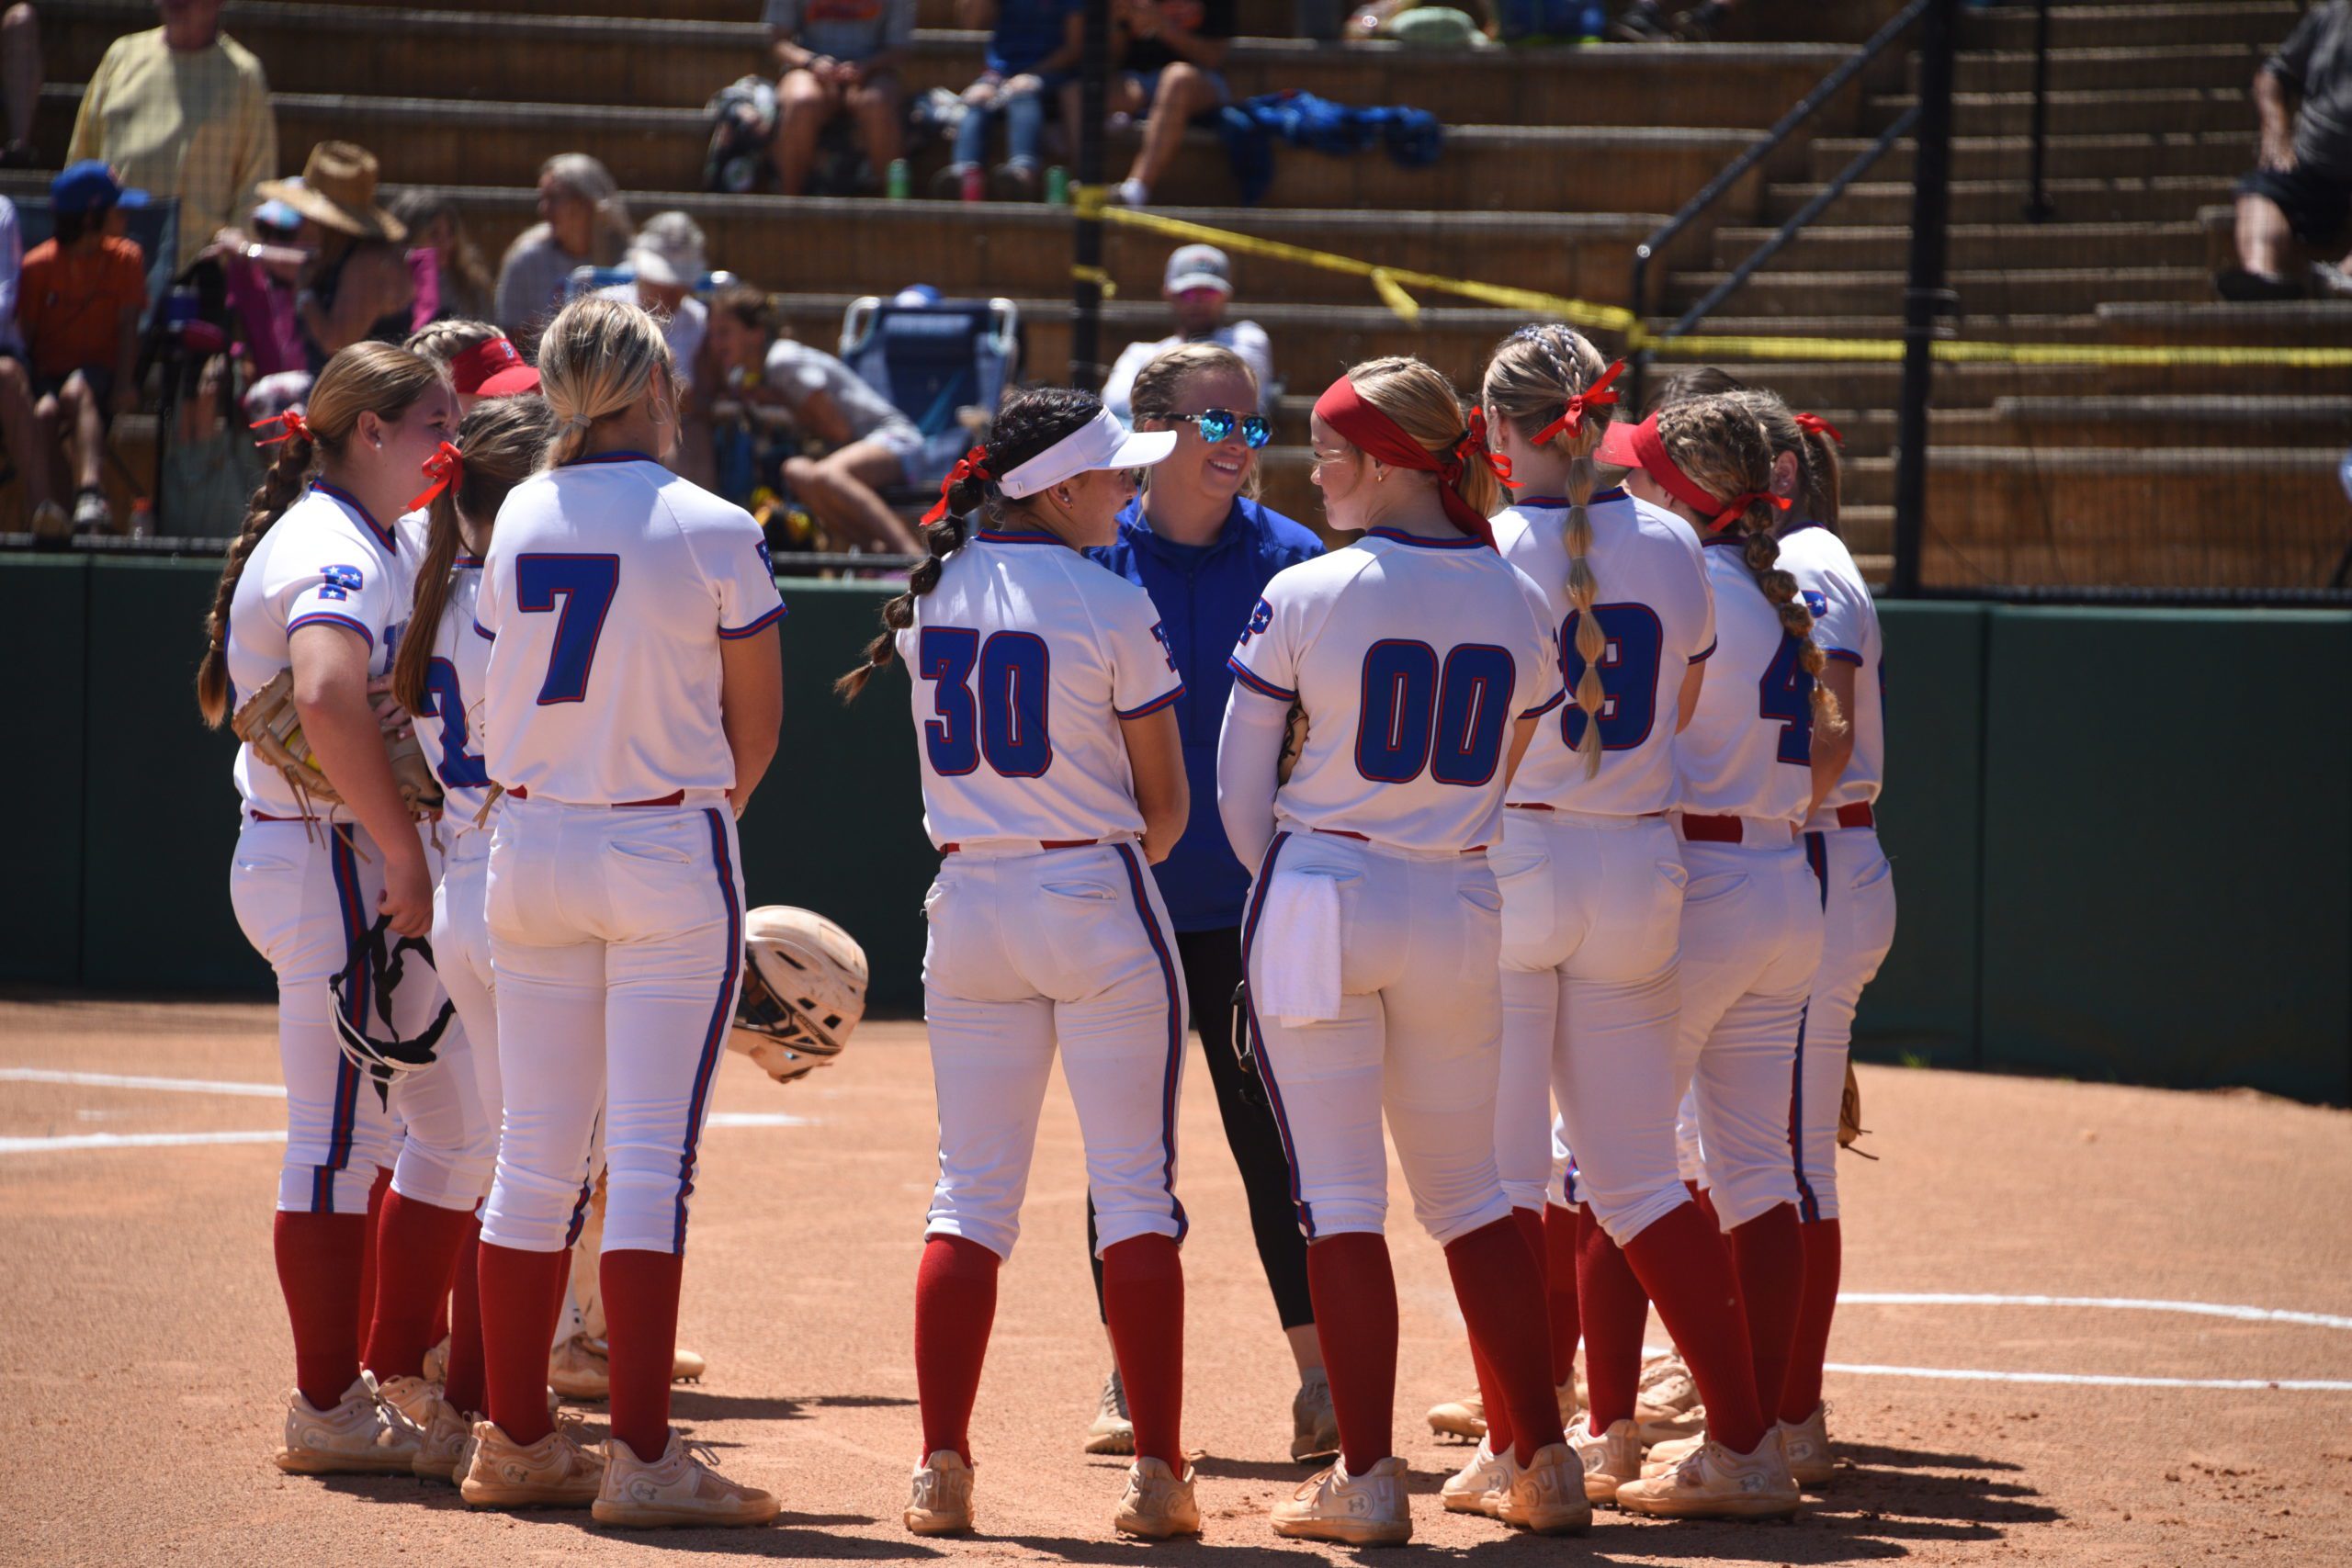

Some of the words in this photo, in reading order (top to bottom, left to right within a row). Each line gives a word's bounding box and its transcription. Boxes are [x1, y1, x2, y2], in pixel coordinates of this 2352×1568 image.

[318, 564, 364, 603] P
[515, 553, 620, 705] 7
[920, 626, 1053, 779] 30
[1354, 638, 1516, 787] 00
[1560, 602, 1664, 751] 9
[1759, 629, 1815, 767] 4
